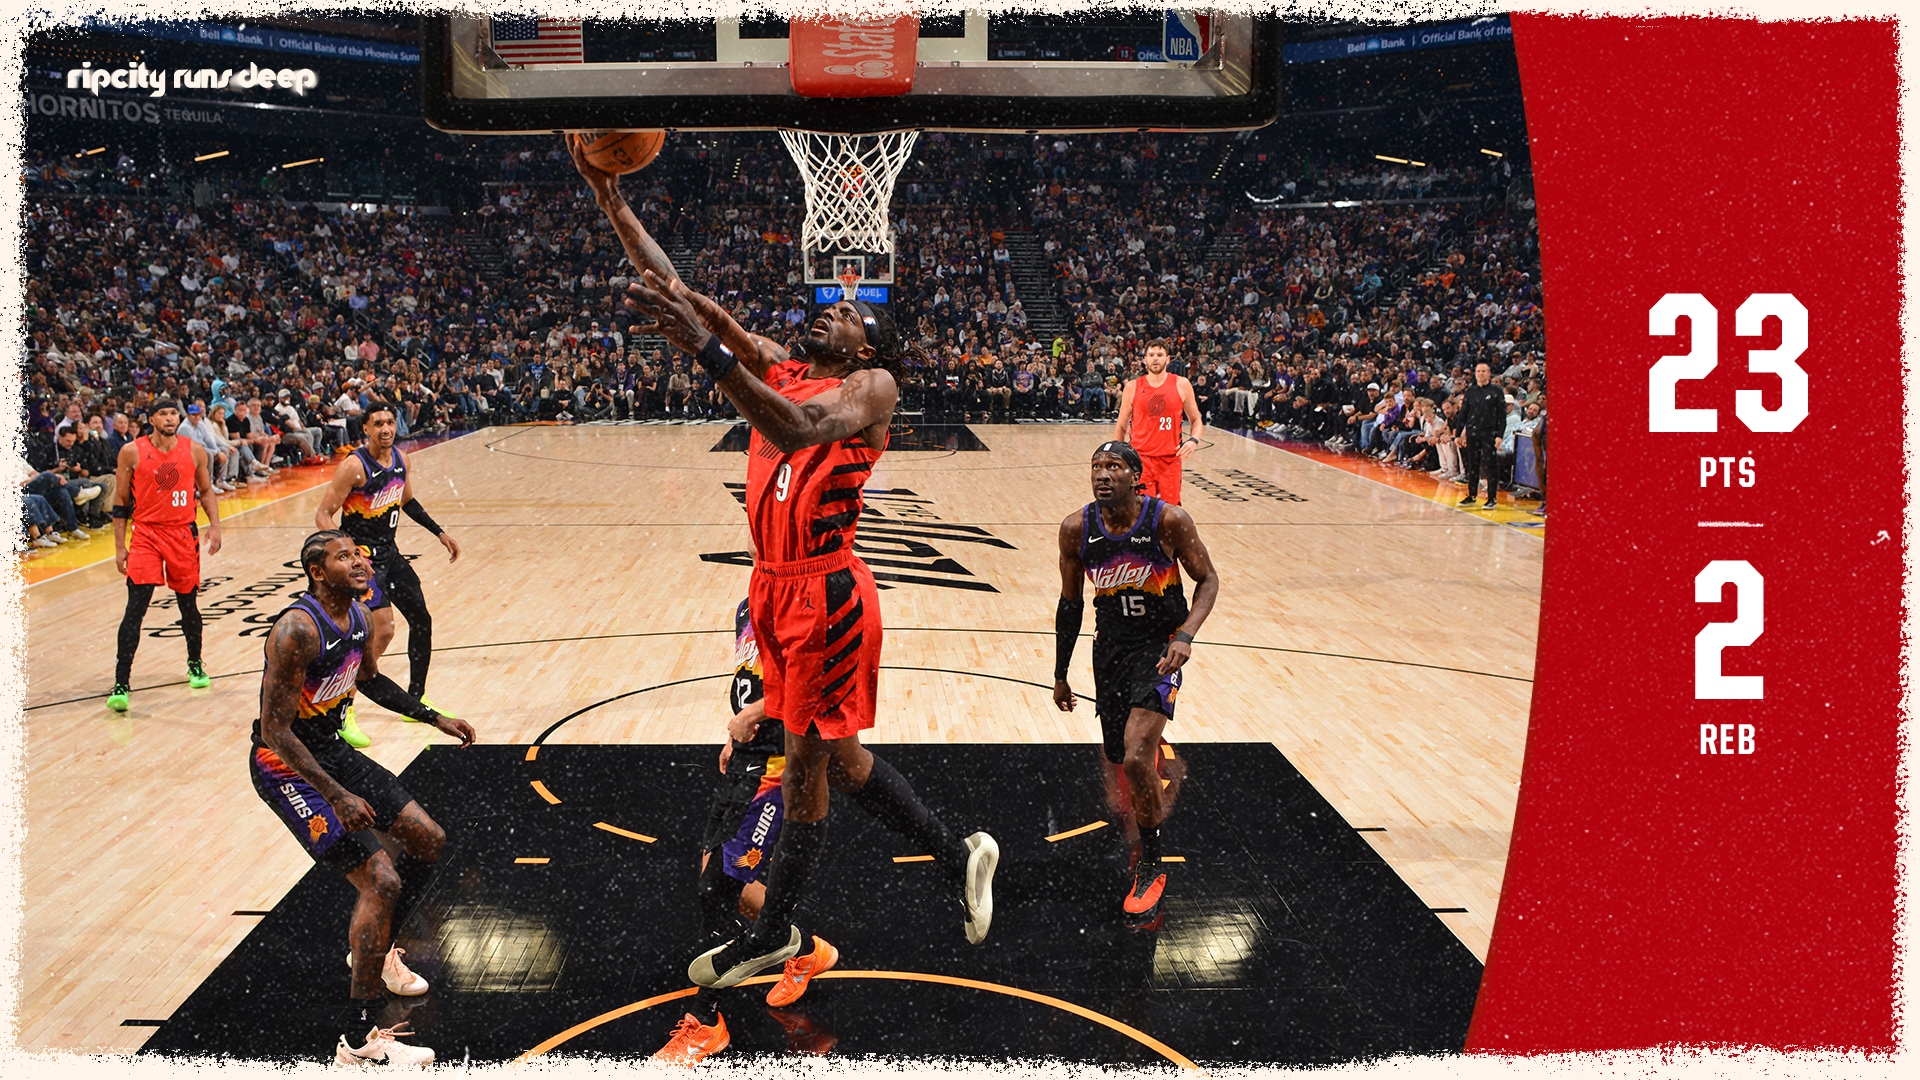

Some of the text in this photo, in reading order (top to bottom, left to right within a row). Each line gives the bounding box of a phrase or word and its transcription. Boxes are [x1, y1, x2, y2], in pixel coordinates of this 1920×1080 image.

[200, 28, 221, 41] Bell
[236, 30, 264, 45] Bank
[279, 37, 314, 51] Official
[314, 41, 337, 53] Bank
[338, 44, 350, 54] of
[349, 44, 364, 56] the
[364, 46, 399, 60] Phoenix
[1170, 37, 1193, 56] NBA
[1347, 24, 1512, 53] Bell Bank Official Bank of the
[165, 108, 223, 124] TEQUILA
[837, 288, 882, 297] FDUEL
[1159, 416, 1172, 431] 23
[775, 462, 792, 502] 9
[171, 489, 188, 508] 33
[389, 510, 399, 528] 0
[1130, 536, 1151, 544] PayPal
[1090, 561, 1153, 589] Valley
[1120, 595, 1146, 616] 15
[279, 782, 313, 819] SUNS
[751, 801, 777, 846] SUNS
